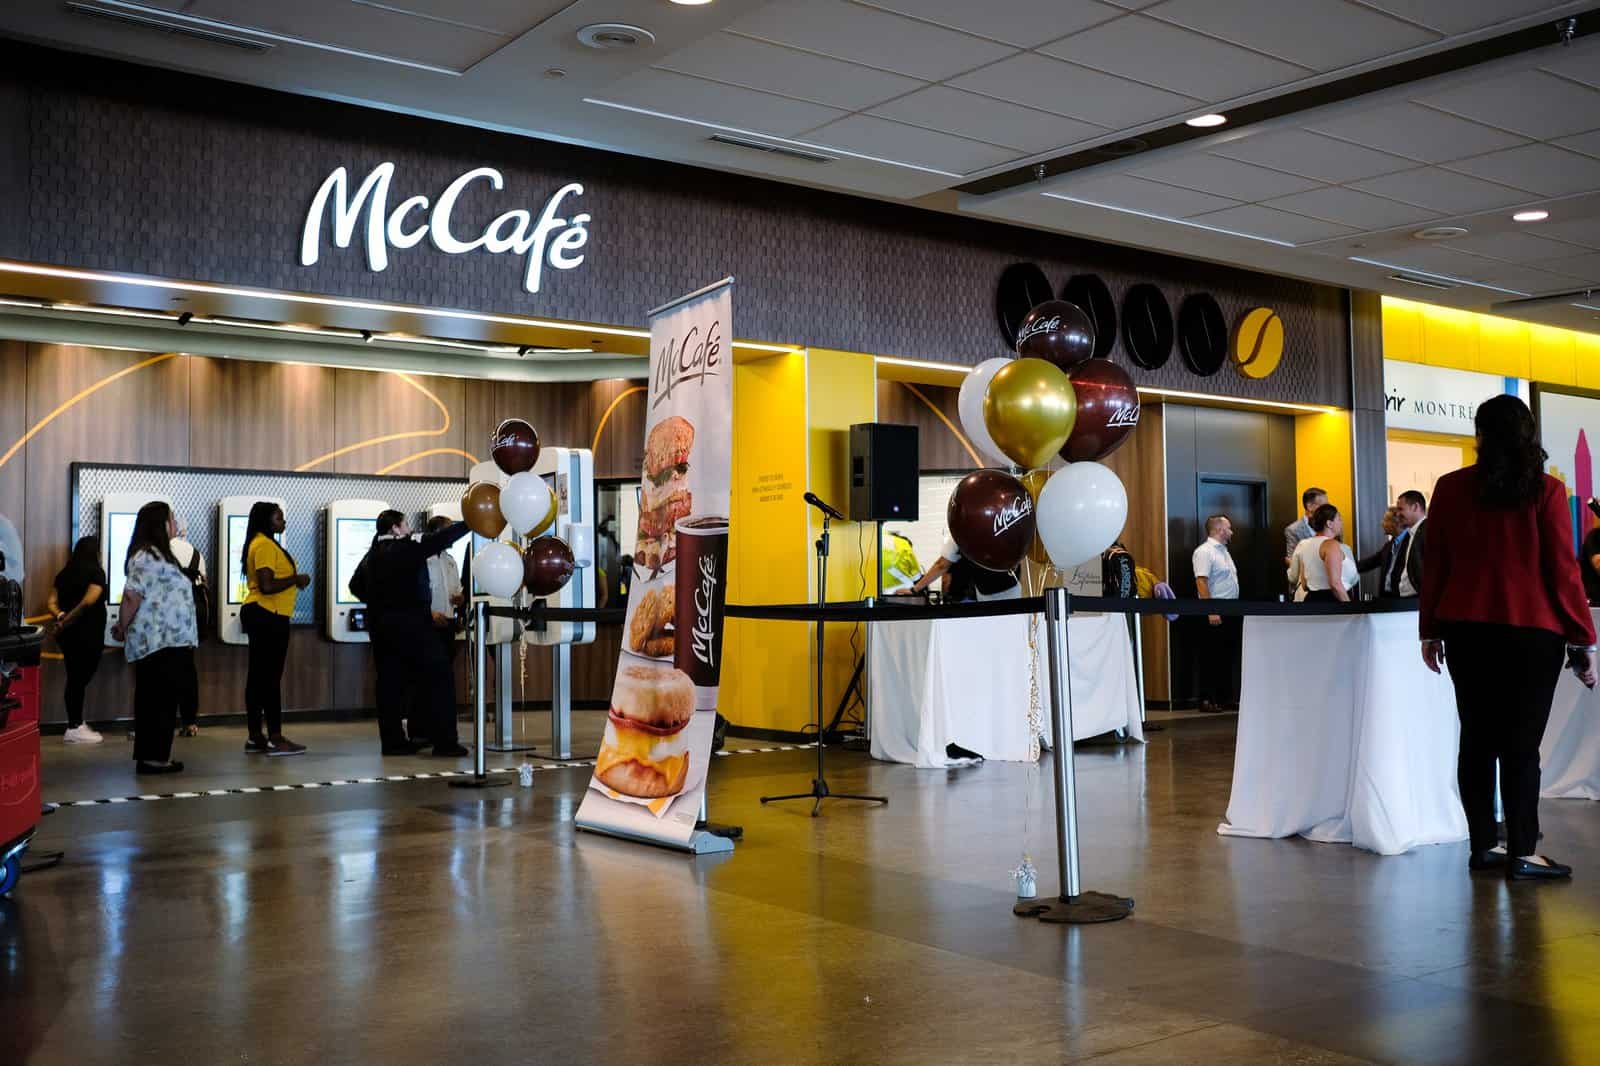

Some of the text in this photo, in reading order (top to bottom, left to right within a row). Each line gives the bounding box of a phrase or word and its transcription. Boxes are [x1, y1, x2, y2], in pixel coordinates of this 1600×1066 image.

[301, 162, 591, 294] McCafé
[654, 320, 721, 401] McCafé
[1107, 407, 1139, 425] McC
[1414, 400, 1475, 420] MONTRÉ
[692, 554, 717, 663] McCafé
